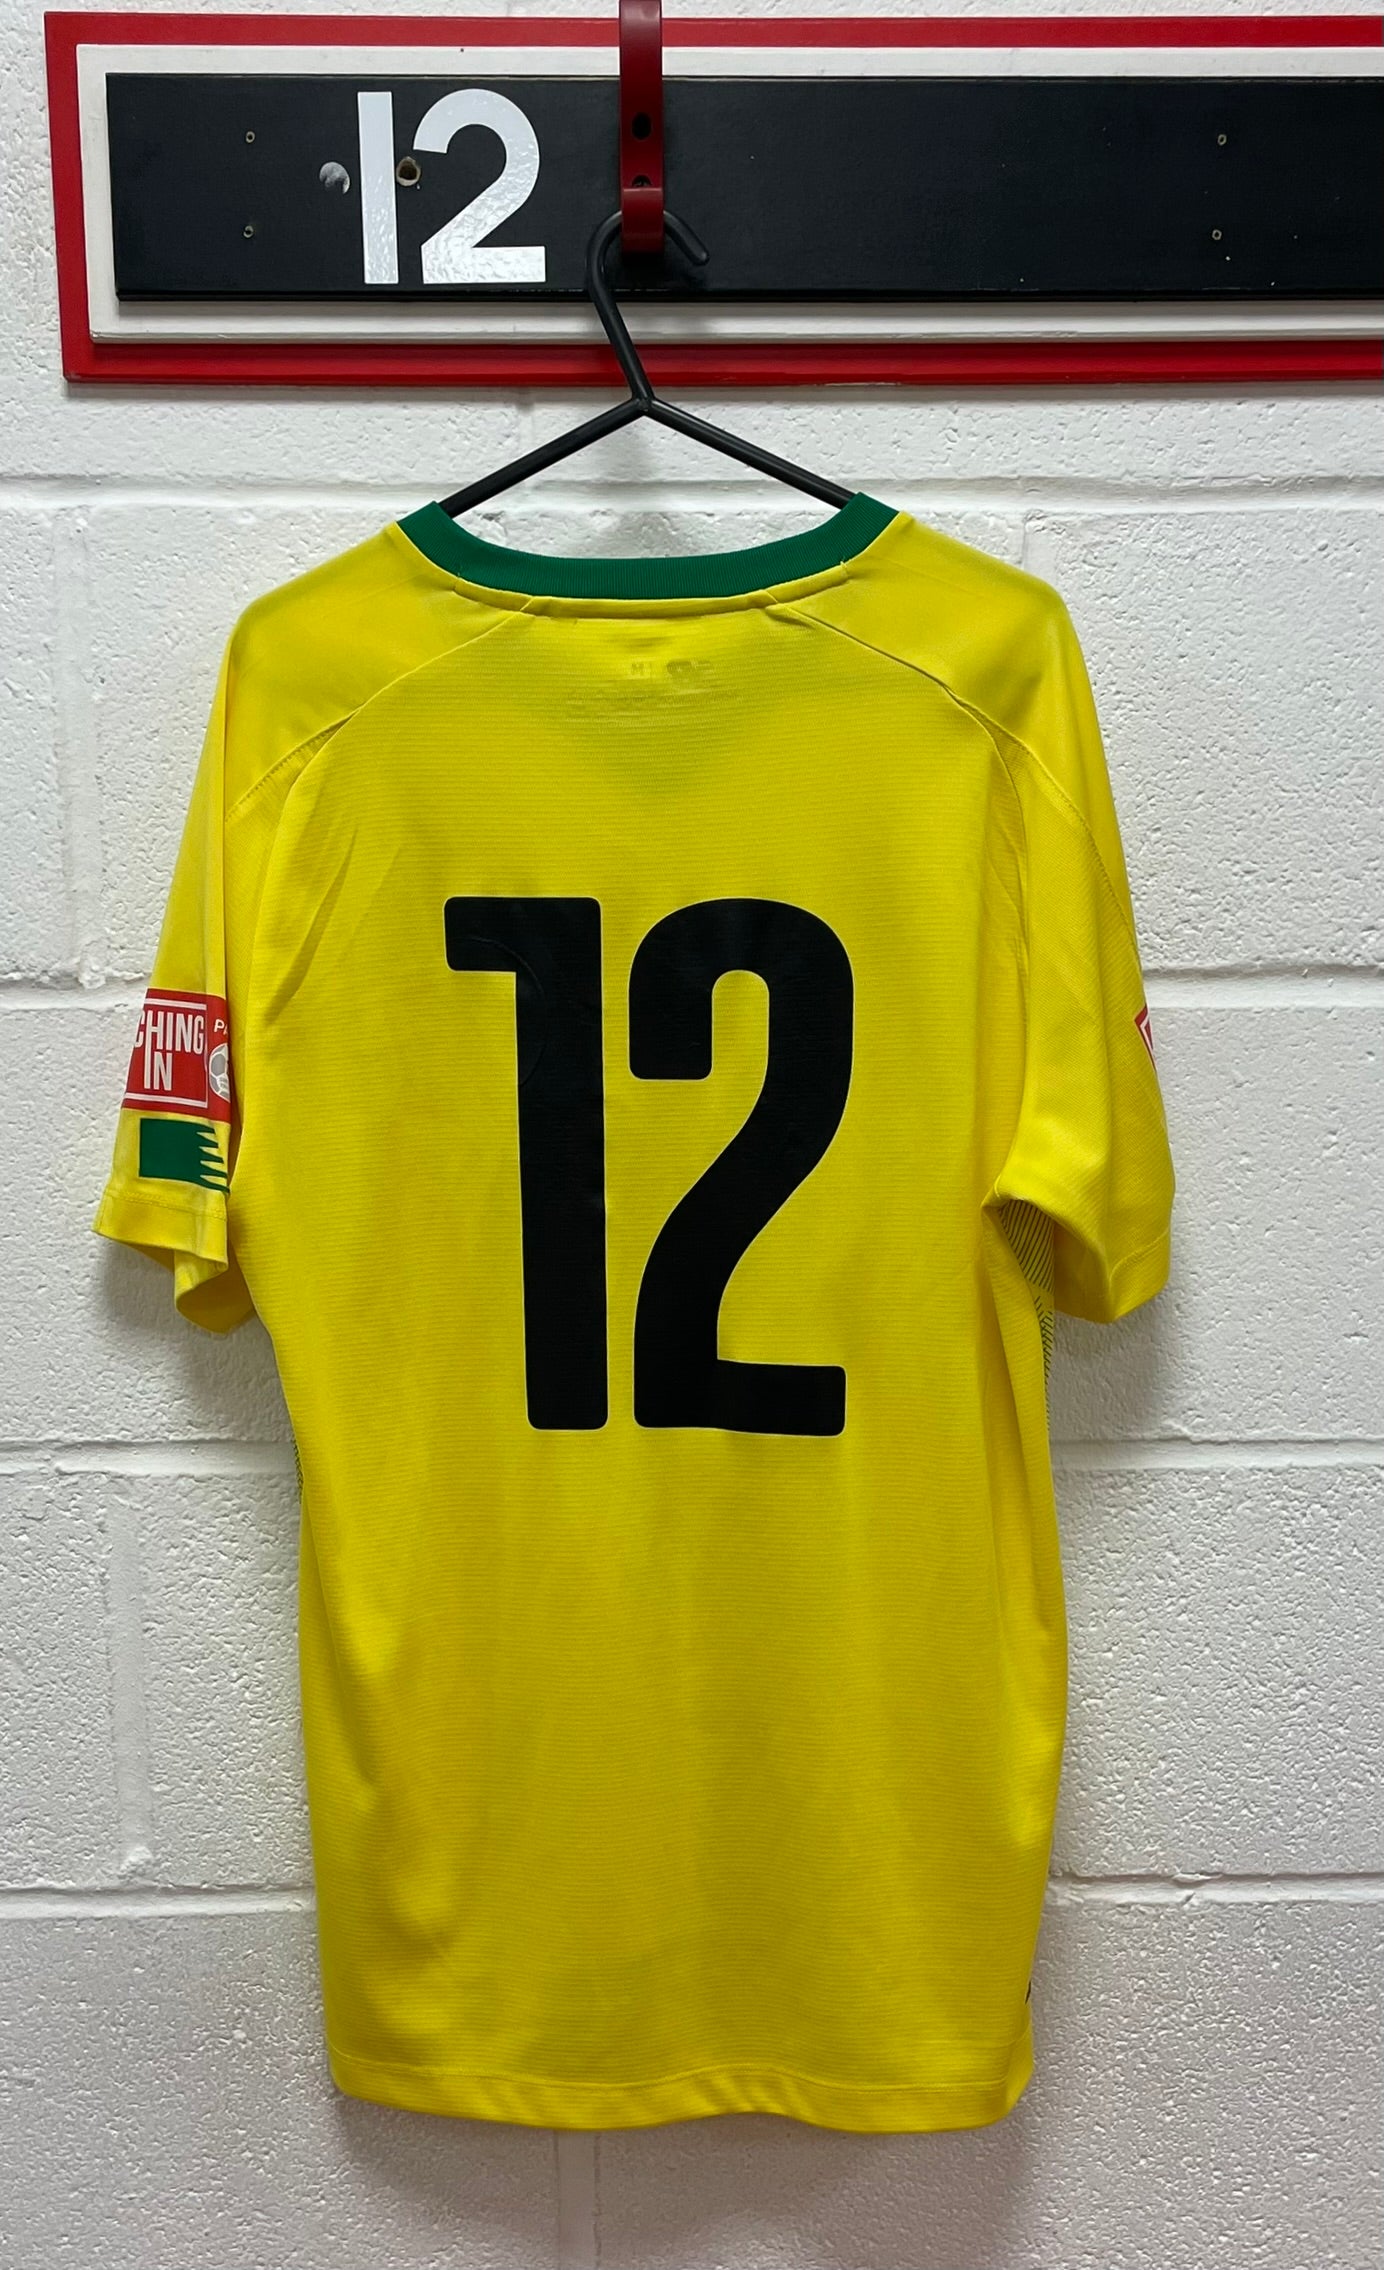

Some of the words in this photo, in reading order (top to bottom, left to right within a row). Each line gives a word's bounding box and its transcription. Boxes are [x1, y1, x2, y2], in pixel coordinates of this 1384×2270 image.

[357, 88, 547, 285] 12
[143, 1050, 174, 1092] IN
[444, 896, 855, 1437] 12
